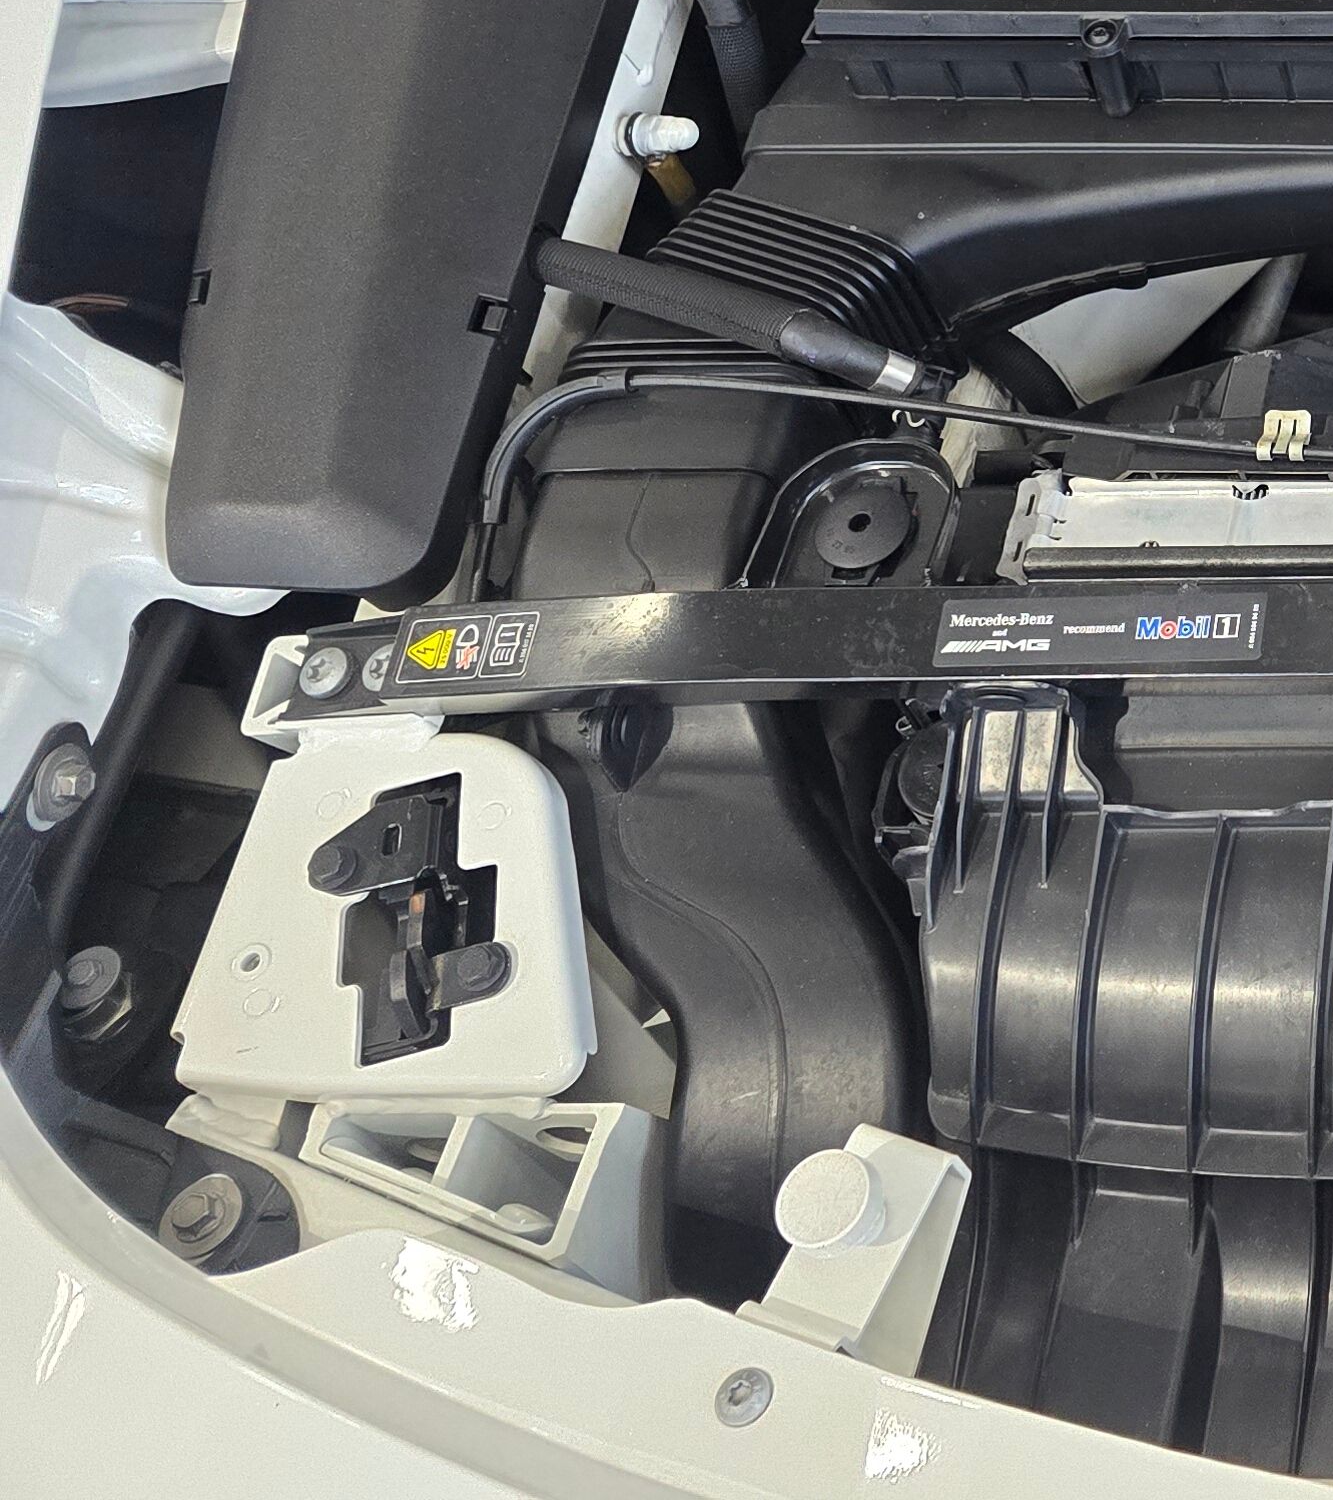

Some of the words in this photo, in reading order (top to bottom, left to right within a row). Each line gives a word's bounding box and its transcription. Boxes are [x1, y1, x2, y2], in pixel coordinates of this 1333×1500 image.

[949, 612, 1055, 628] Mercedes-Benz
[1063, 622, 1126, 634] recommend
[1135, 614, 1212, 640] Mobil
